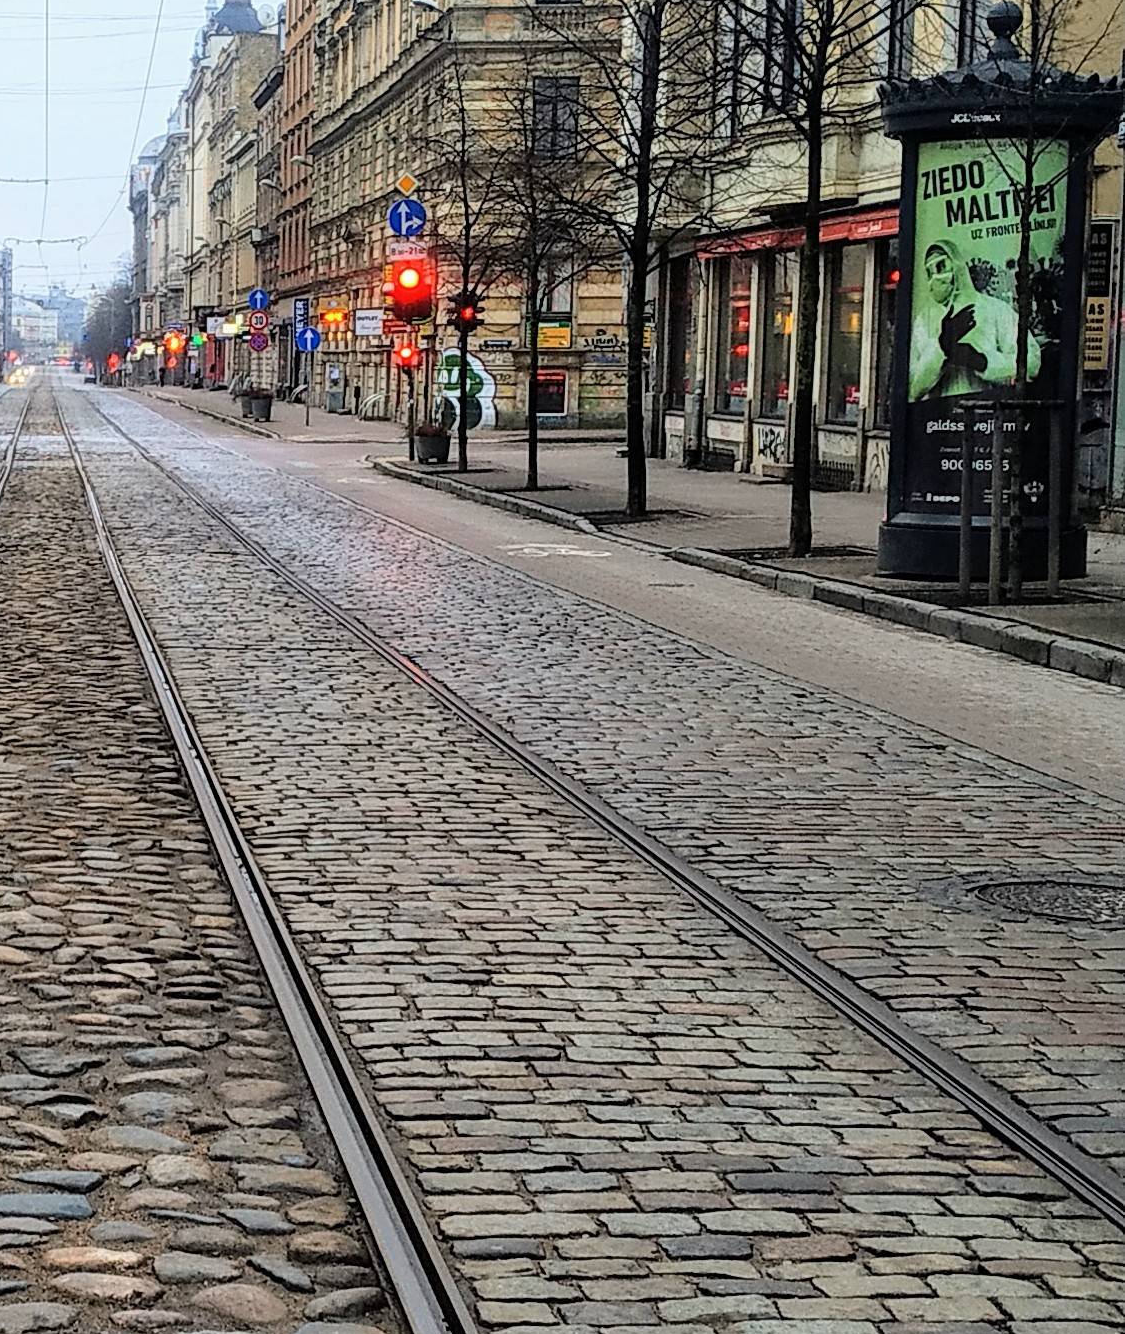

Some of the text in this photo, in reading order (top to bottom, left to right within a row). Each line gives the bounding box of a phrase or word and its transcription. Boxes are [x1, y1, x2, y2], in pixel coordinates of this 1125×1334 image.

[921, 160, 985, 200] ZIEDO
[970, 229, 984, 240] UZ
[986, 223, 1025, 238] FRONTE
[254, 316, 264, 326] 30
[941, 459, 1010, 471] 900655
